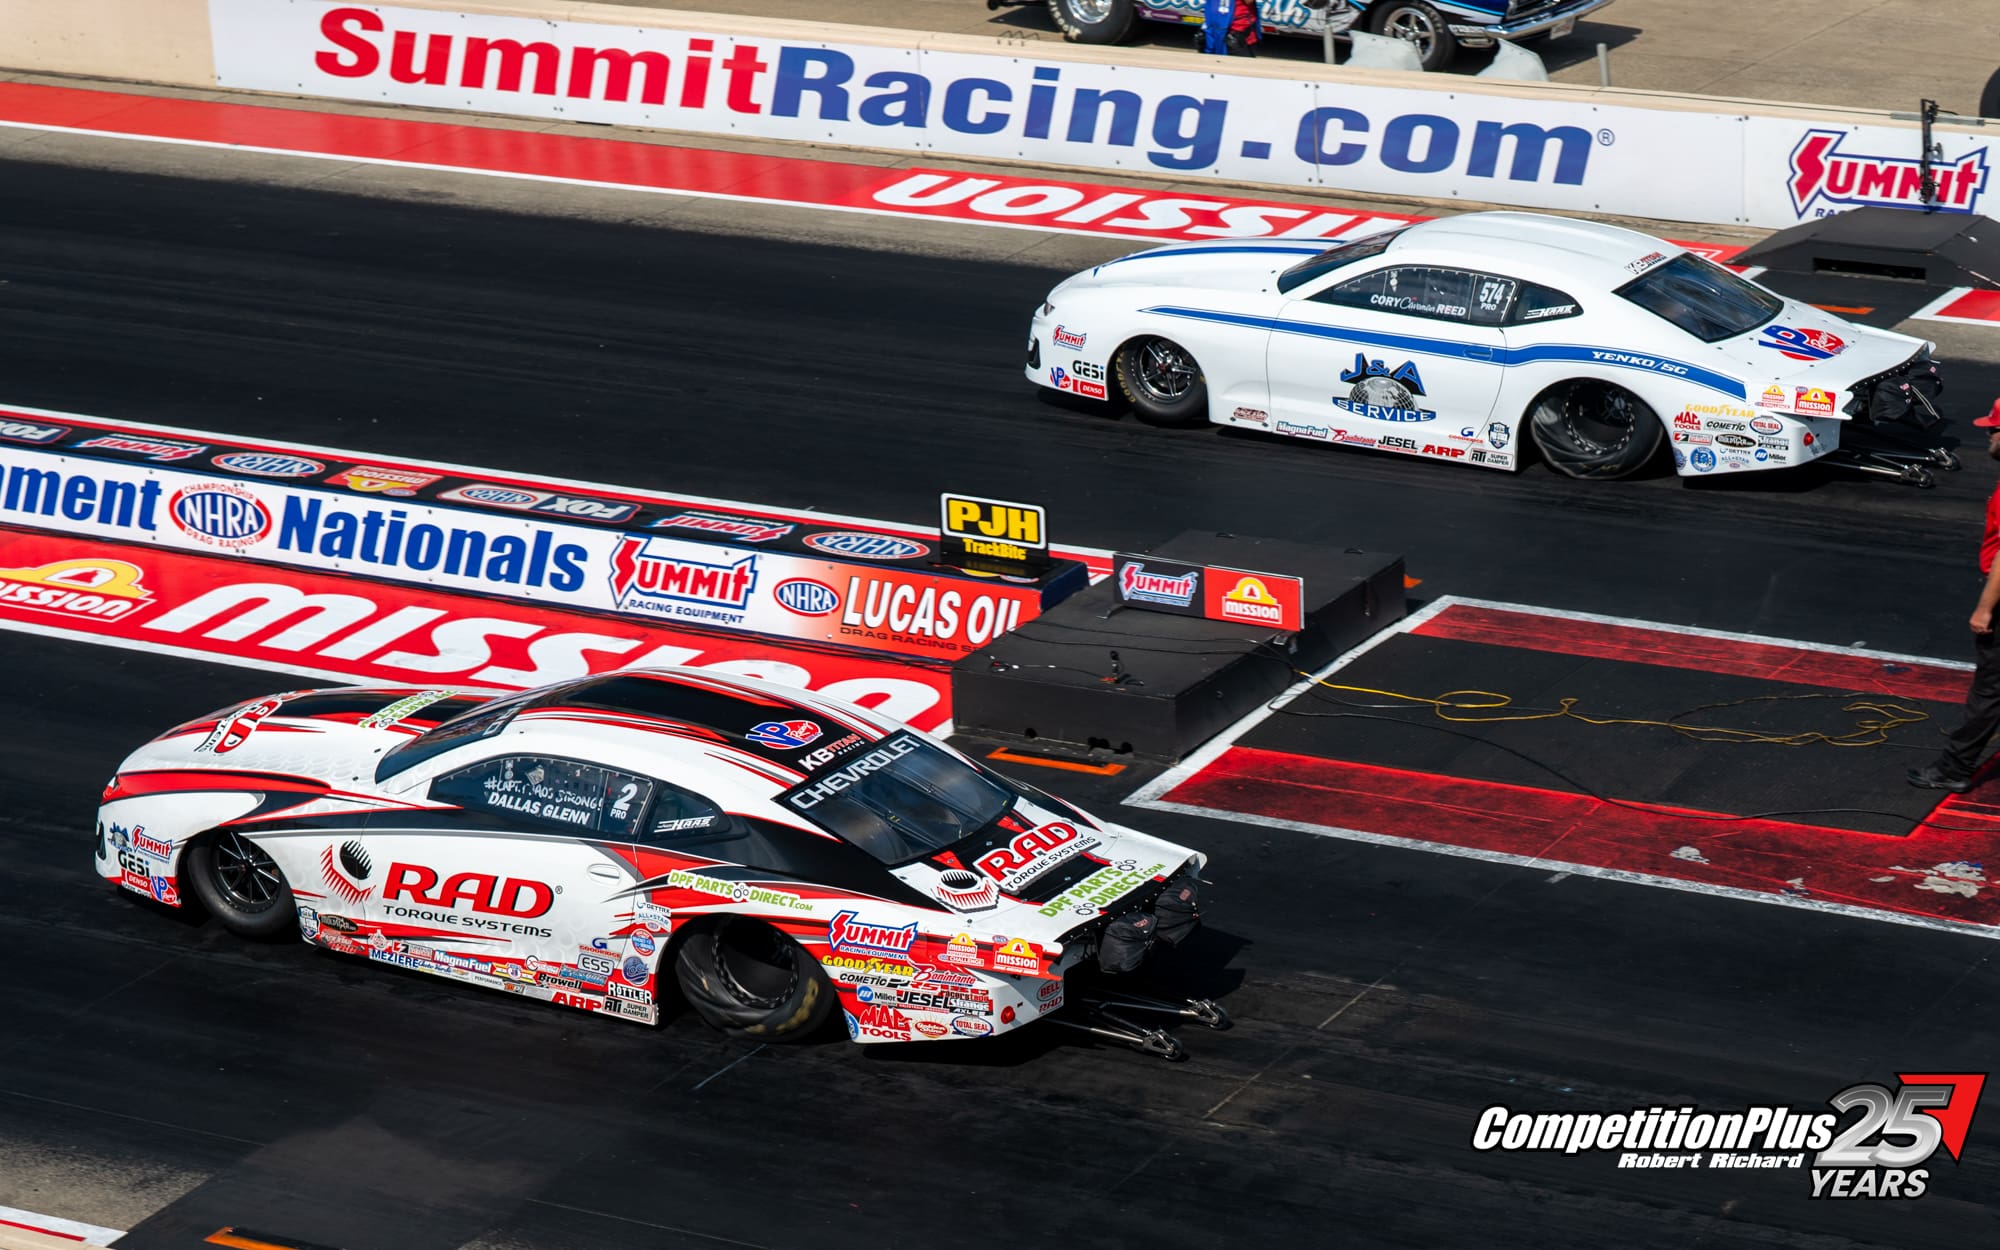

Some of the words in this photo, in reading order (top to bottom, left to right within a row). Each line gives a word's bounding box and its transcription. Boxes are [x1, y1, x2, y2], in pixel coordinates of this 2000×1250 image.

[314, 7, 1594, 187] SummitRacing.com
[873, 173, 1410, 238] ission
[1479, 282, 1505, 305] 574
[1370, 294, 1401, 307] CORY
[1436, 304, 1466, 316] REED
[1480, 303, 1497, 311] PRO
[1339, 352, 1427, 397] J&A
[1082, 385, 1103, 395] DENSO
[1335, 399, 1432, 421] SERVICE
[1674, 411, 1701, 425] MAC
[1276, 420, 1329, 438] MagnaFuel
[1674, 423, 1701, 431] TOOLS
[1378, 435, 1418, 450] JESEL
[1422, 444, 1465, 458] ARP
[231, 455, 311, 475] NHRA
[1487, 458, 1510, 466] DAMPER
[1490, 452, 1508, 460] SUPER
[184, 483, 255, 501] CHAMPIONSHIP
[465, 488, 530, 504] NHRA
[184, 494, 259, 537] NHRA
[549, 495, 630, 520] FOX
[0, 464, 162, 531] ment
[277, 495, 588, 593] Nationals
[948, 499, 1040, 543] PJH
[186, 527, 214, 546] DRAG
[218, 536, 255, 549] RACING
[817, 534, 915, 556] NHRA
[962, 538, 1028, 561] TrackBite
[780, 582, 834, 613] NHRA
[841, 575, 962, 640] LUCAS
[628, 599, 673, 613] RACING
[675, 606, 745, 624] EQUIPMENT
[840, 626, 889, 641] DRAG
[891, 634, 959, 652] RACING
[745, 721, 806, 747] VP
[798, 748, 835, 771] KB
[826, 733, 861, 752] TITAN
[837, 740, 866, 756] RACING
[790, 734, 921, 809] CHEVROLET
[555, 790, 603, 811] STRONG!
[614, 783, 639, 811] 2
[487, 791, 542, 815] DALLAS
[542, 804, 591, 826] GLENN
[610, 808, 627, 820] PRO
[977, 822, 1078, 882] RAD
[1005, 859, 1050, 890] TORQUE
[1050, 836, 1096, 863] SYSTEMS
[128, 875, 148, 887] DENSO
[383, 862, 556, 919] RAD
[669, 871, 693, 886] DPF
[695, 877, 735, 896] PARTS
[1038, 896, 1073, 918] DPF
[1071, 868, 1122, 900] PARTS
[383, 904, 458, 926] TORQUE
[461, 916, 553, 938] SYSTEMS
[371, 949, 419, 969] MEZIERE
[433, 949, 492, 974] MagnaFuel
[840, 945, 867, 955] RACING
[866, 948, 908, 960] EQUIPMENT
[949, 956, 984, 966] CHALLENGE
[581, 956, 611, 974] ESS
[822, 955, 914, 977] GOODYEAR
[538, 972, 582, 989] Browell
[1039, 982, 1060, 997] BELL
[551, 991, 602, 1011] ARP
[607, 981, 653, 1004] ROTTLER
[874, 991, 897, 1002] Miller
[897, 990, 950, 1009] JESEL
[622, 1007, 649, 1020] DAMPER
[626, 1002, 647, 1013] SUPER
[1039, 996, 1063, 1012] RAD
[859, 1004, 913, 1032] MAC
[956, 1020, 973, 1029] TOTAL
[973, 1022, 989, 1031] SEAL
[860, 1026, 912, 1041] TOOLS
